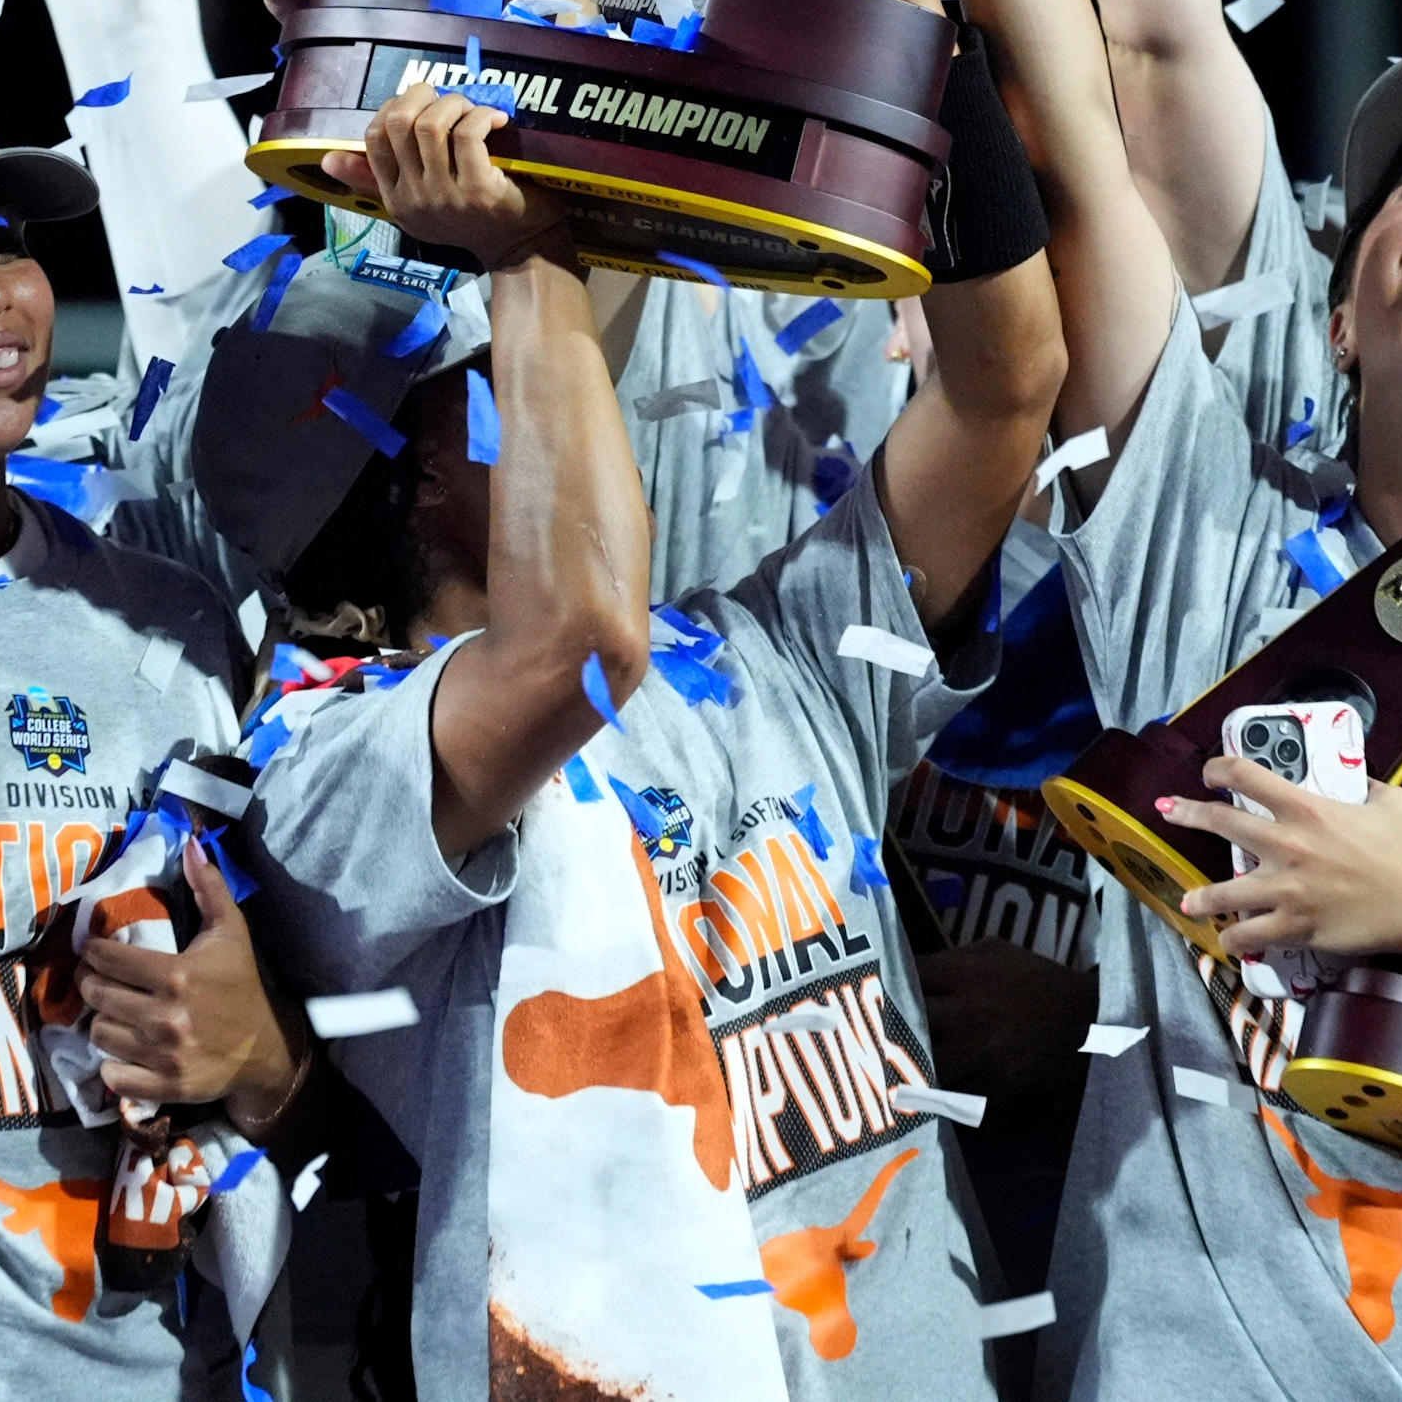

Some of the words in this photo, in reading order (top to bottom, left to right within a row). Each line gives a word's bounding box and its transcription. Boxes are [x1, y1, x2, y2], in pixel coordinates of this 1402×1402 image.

[569, 83, 770, 154] CHAMPION
[27, 718, 72, 733] COLLEGE
[12, 731, 51, 747] WORLD
[53, 733, 88, 749] SERIES
[6, 782, 117, 809] DIVISION
